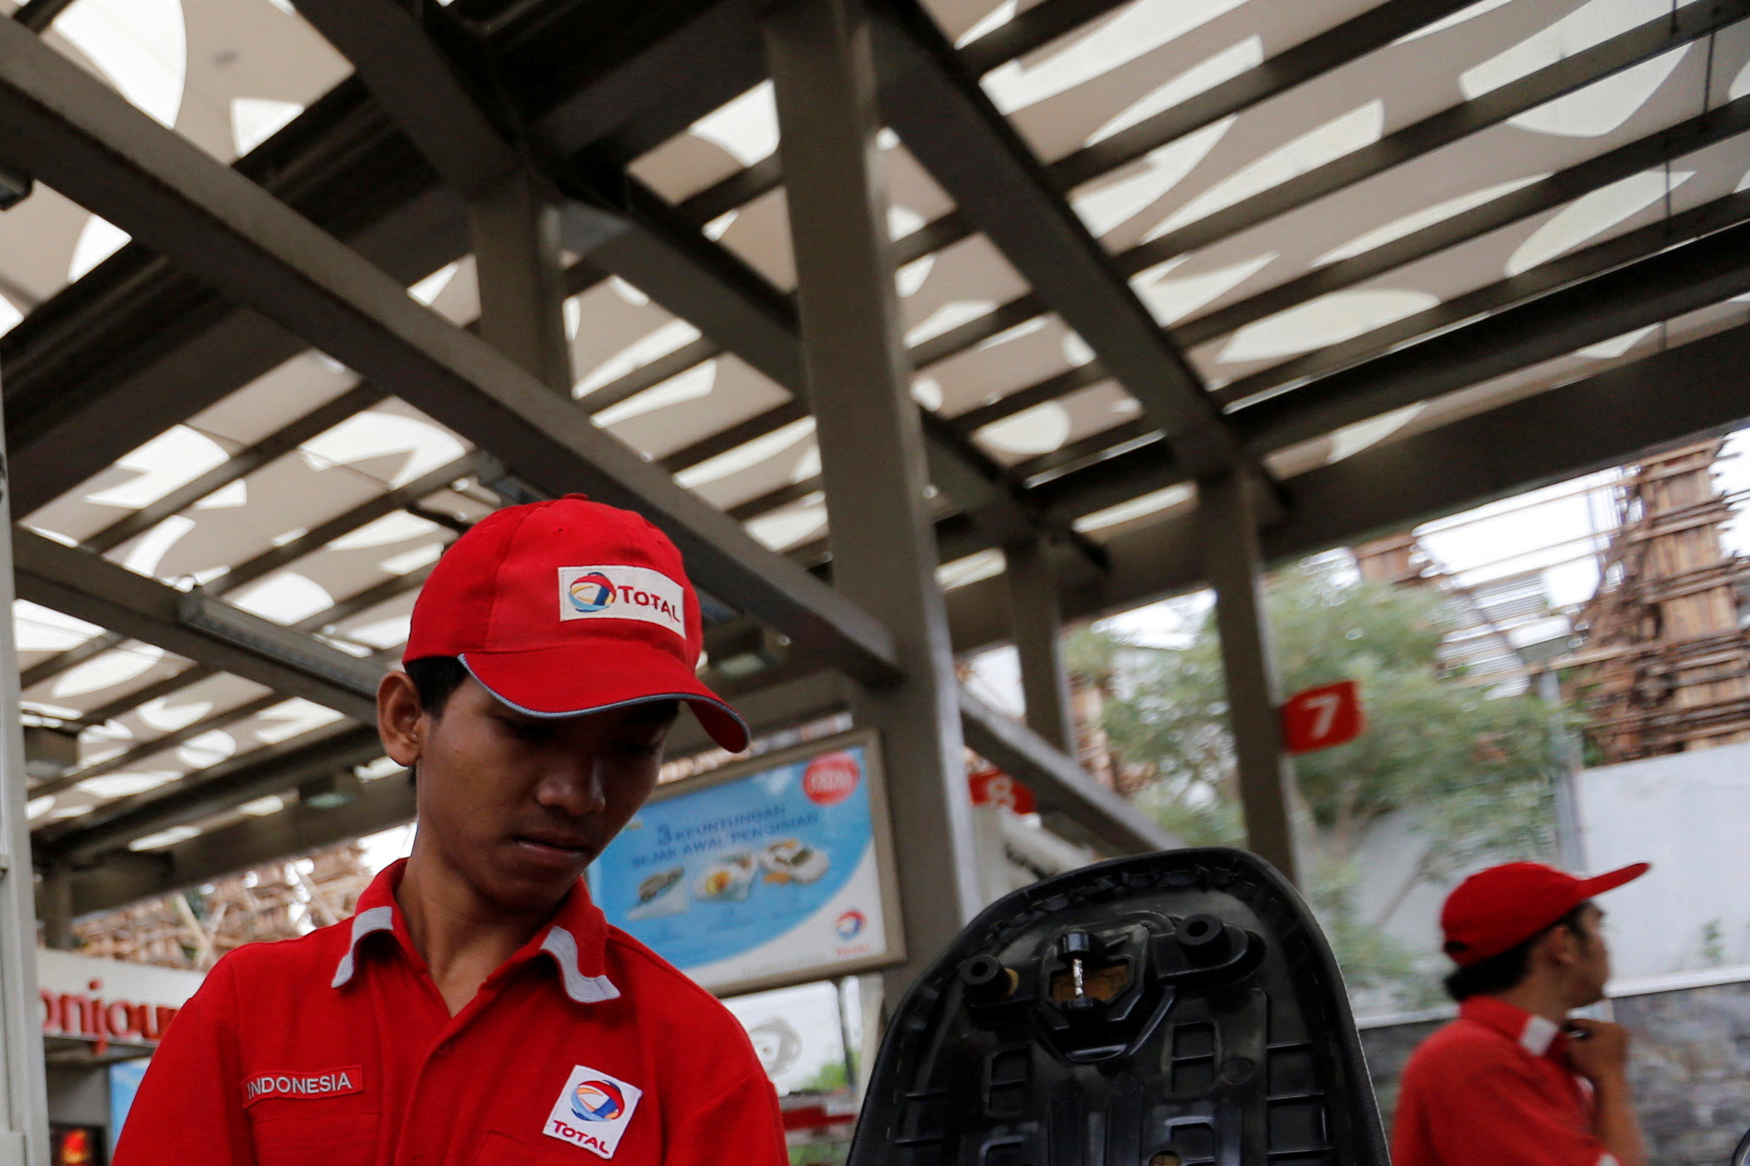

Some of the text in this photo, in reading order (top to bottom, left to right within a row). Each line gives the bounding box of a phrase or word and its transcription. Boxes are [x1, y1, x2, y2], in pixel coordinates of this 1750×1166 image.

[617, 585, 681, 622] TOTAL
[1303, 694, 1341, 739] 7
[657, 822, 672, 845] 3
[39, 979, 179, 1055] onjou
[247, 1072, 353, 1099] INDONESIA
[553, 1120, 610, 1155] TOTAL
